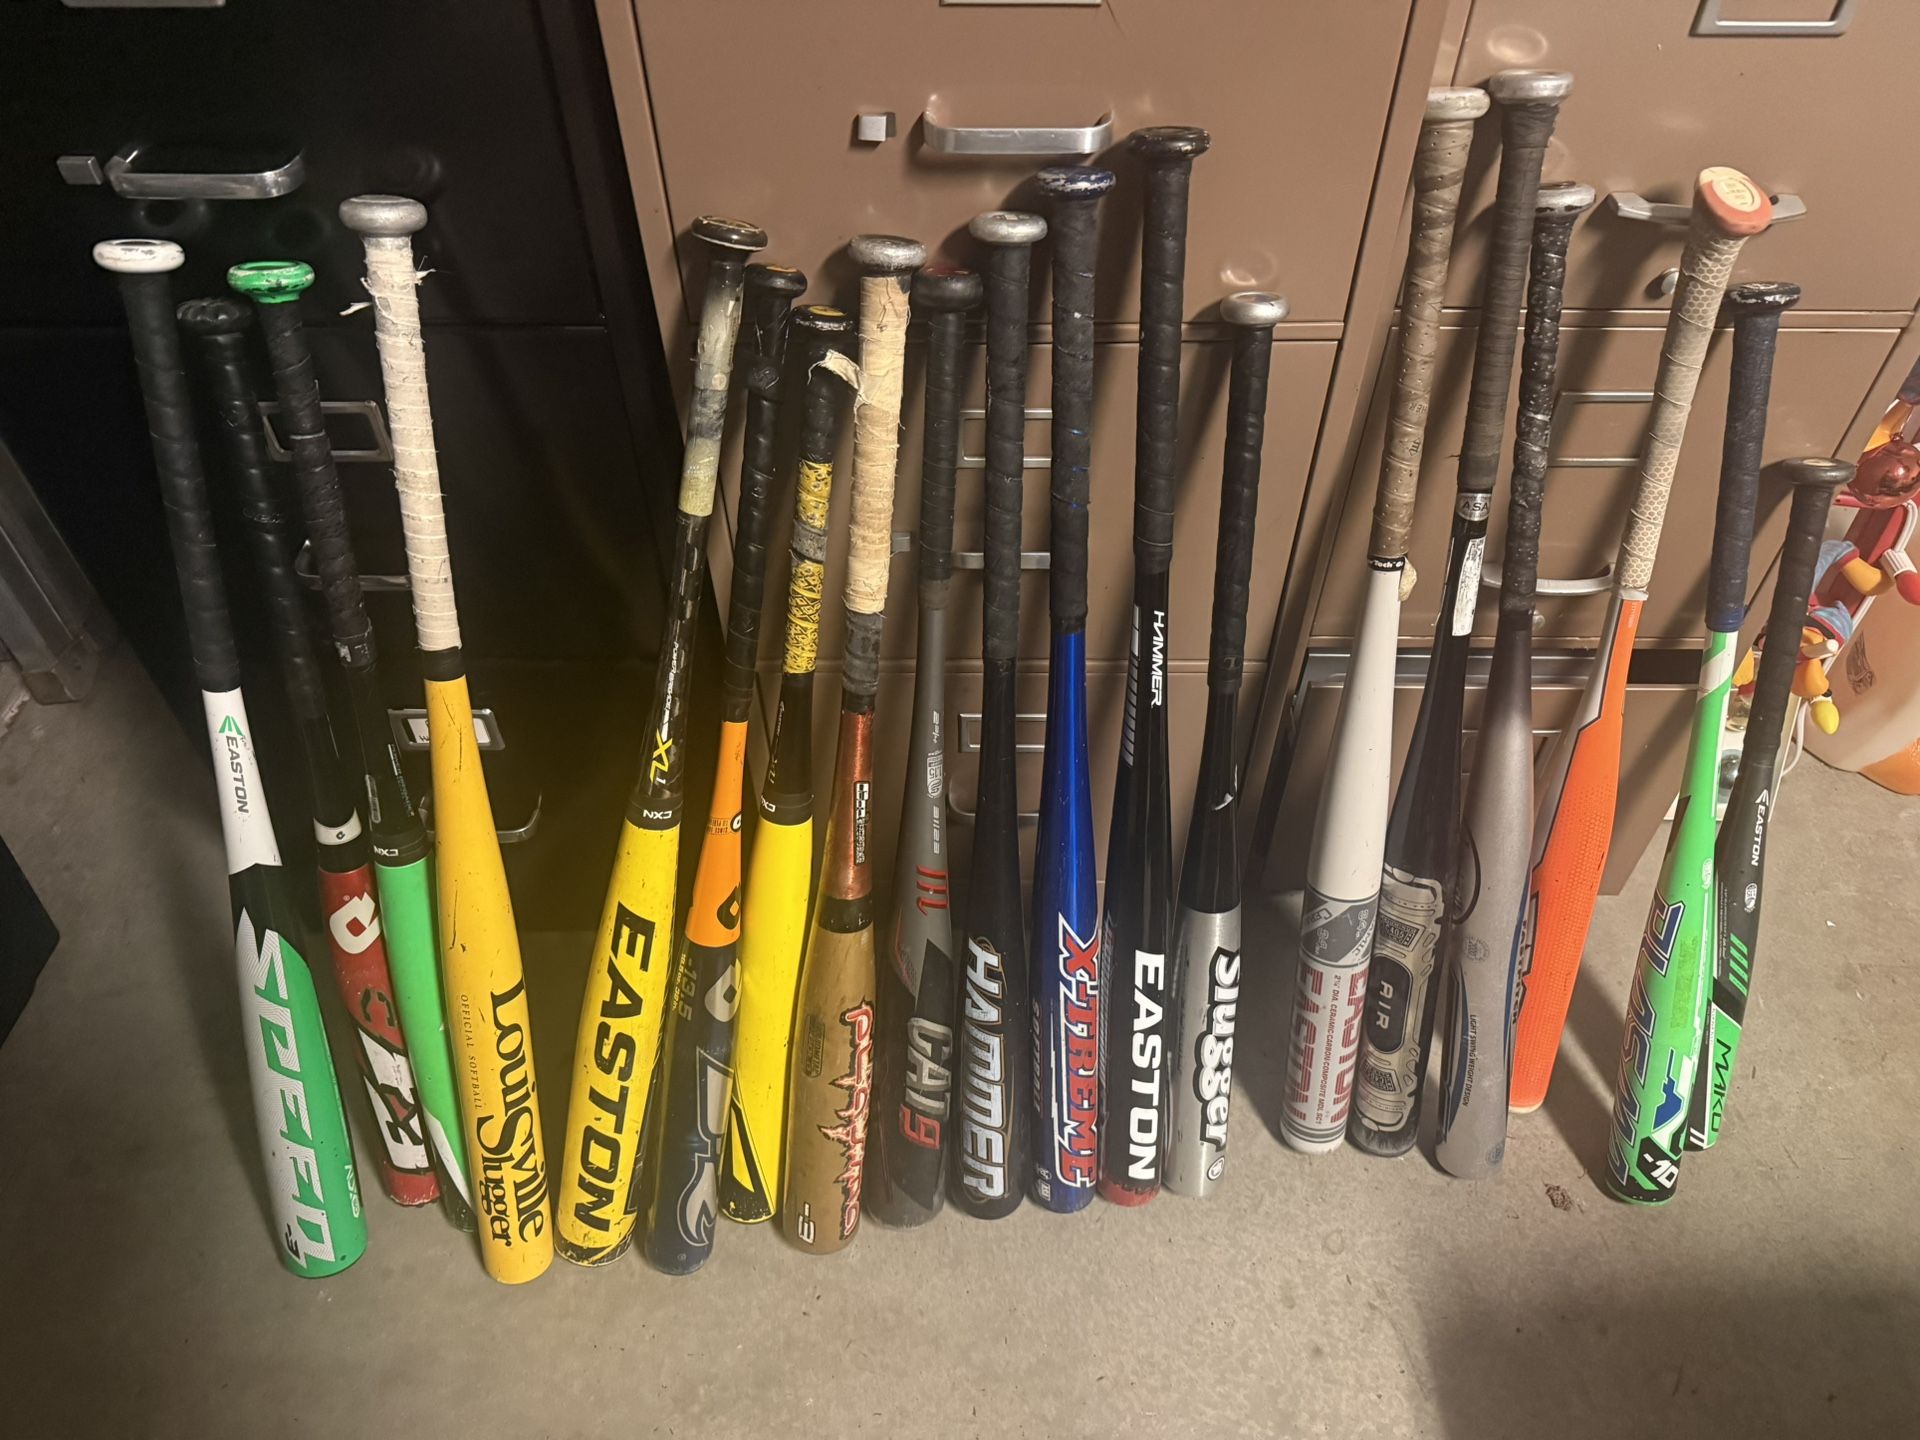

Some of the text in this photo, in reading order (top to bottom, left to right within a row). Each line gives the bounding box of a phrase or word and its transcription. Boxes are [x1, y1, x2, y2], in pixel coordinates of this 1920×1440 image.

[1462, 500, 1489, 512] ASA
[1149, 609, 1164, 709] HAMMER
[225, 734, 249, 815] EASTON
[1750, 804, 1768, 868] EASTON
[459, 993, 483, 1112] OFFICIAL SOFTBALL
[1057, 914, 1100, 1189] X-TREME
[1197, 954, 1241, 1147] Slugger
[1330, 968, 1369, 1123] EASTON
[1375, 979, 1394, 1031] AIR
[1461, 1014, 1477, 1107] LIGHT SWING WEIGHT DESIGN
[1606, 896, 1686, 1187] PLASMA
[249, 926, 337, 1269] SPEED
[575, 901, 657, 1236] EASTON
[963, 937, 1006, 1200] HAMMER
[1128, 949, 1166, 1181] EASTON
[1710, 1037, 1732, 1133] MAKO
[474, 1114, 513, 1248] Slugger
[796, 1203, 818, 1244] -3
[1642, 1152, 1680, 1189] -10
